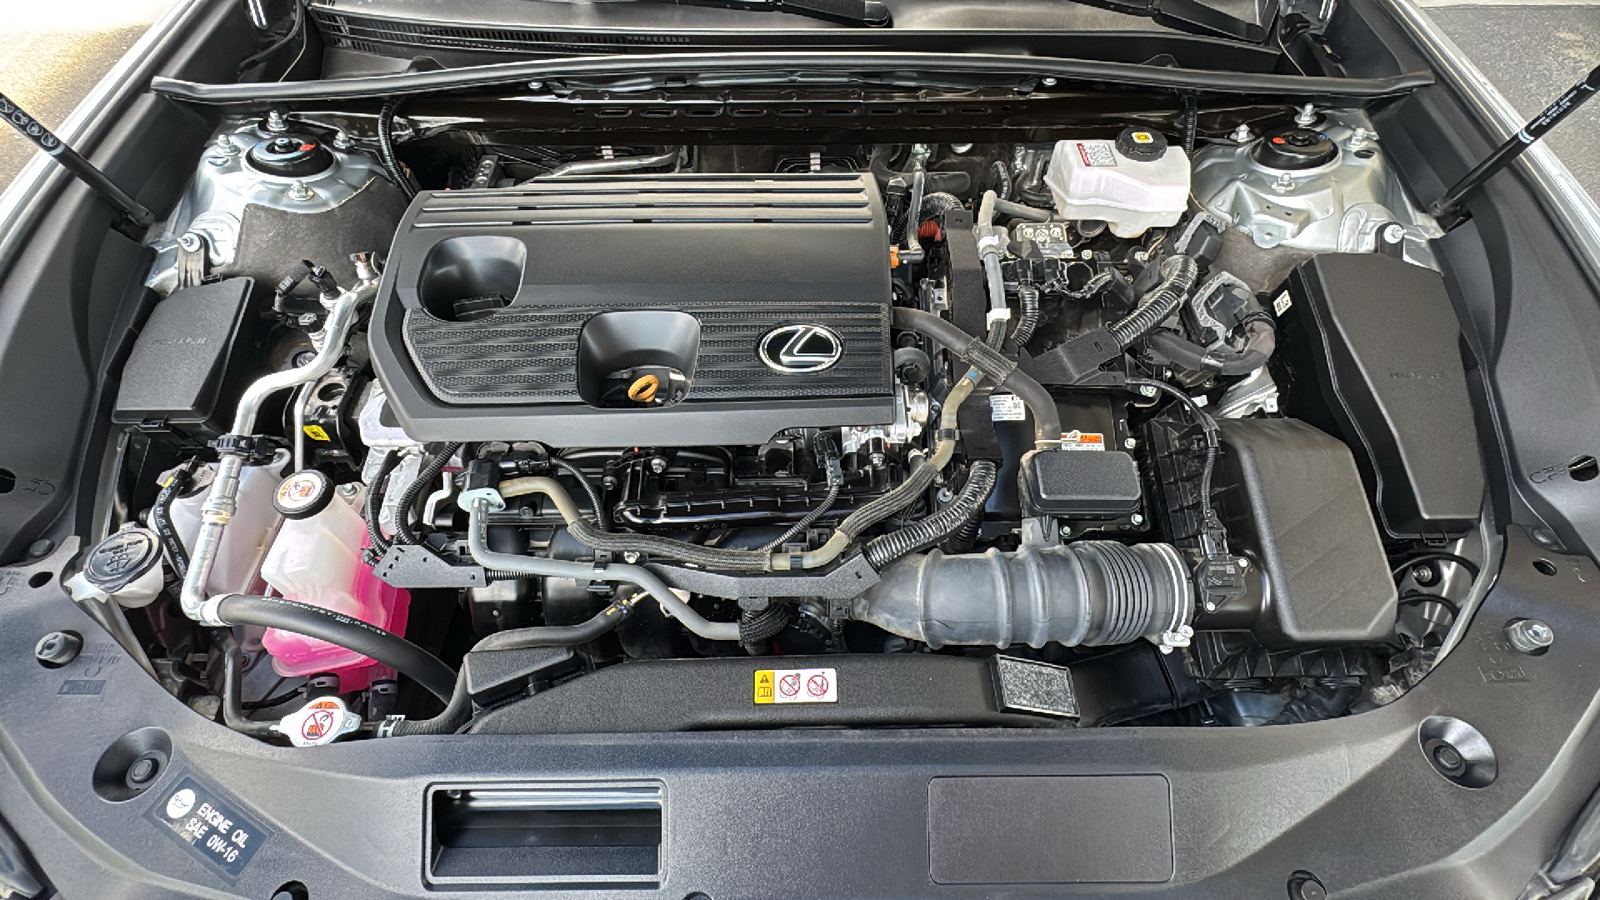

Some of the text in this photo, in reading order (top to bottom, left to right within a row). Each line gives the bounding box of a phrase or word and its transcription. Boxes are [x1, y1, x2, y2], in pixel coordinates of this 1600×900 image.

[185, 817, 239, 862] SAE 0W-16
[197, 802, 249, 849] ENGINE OIL
